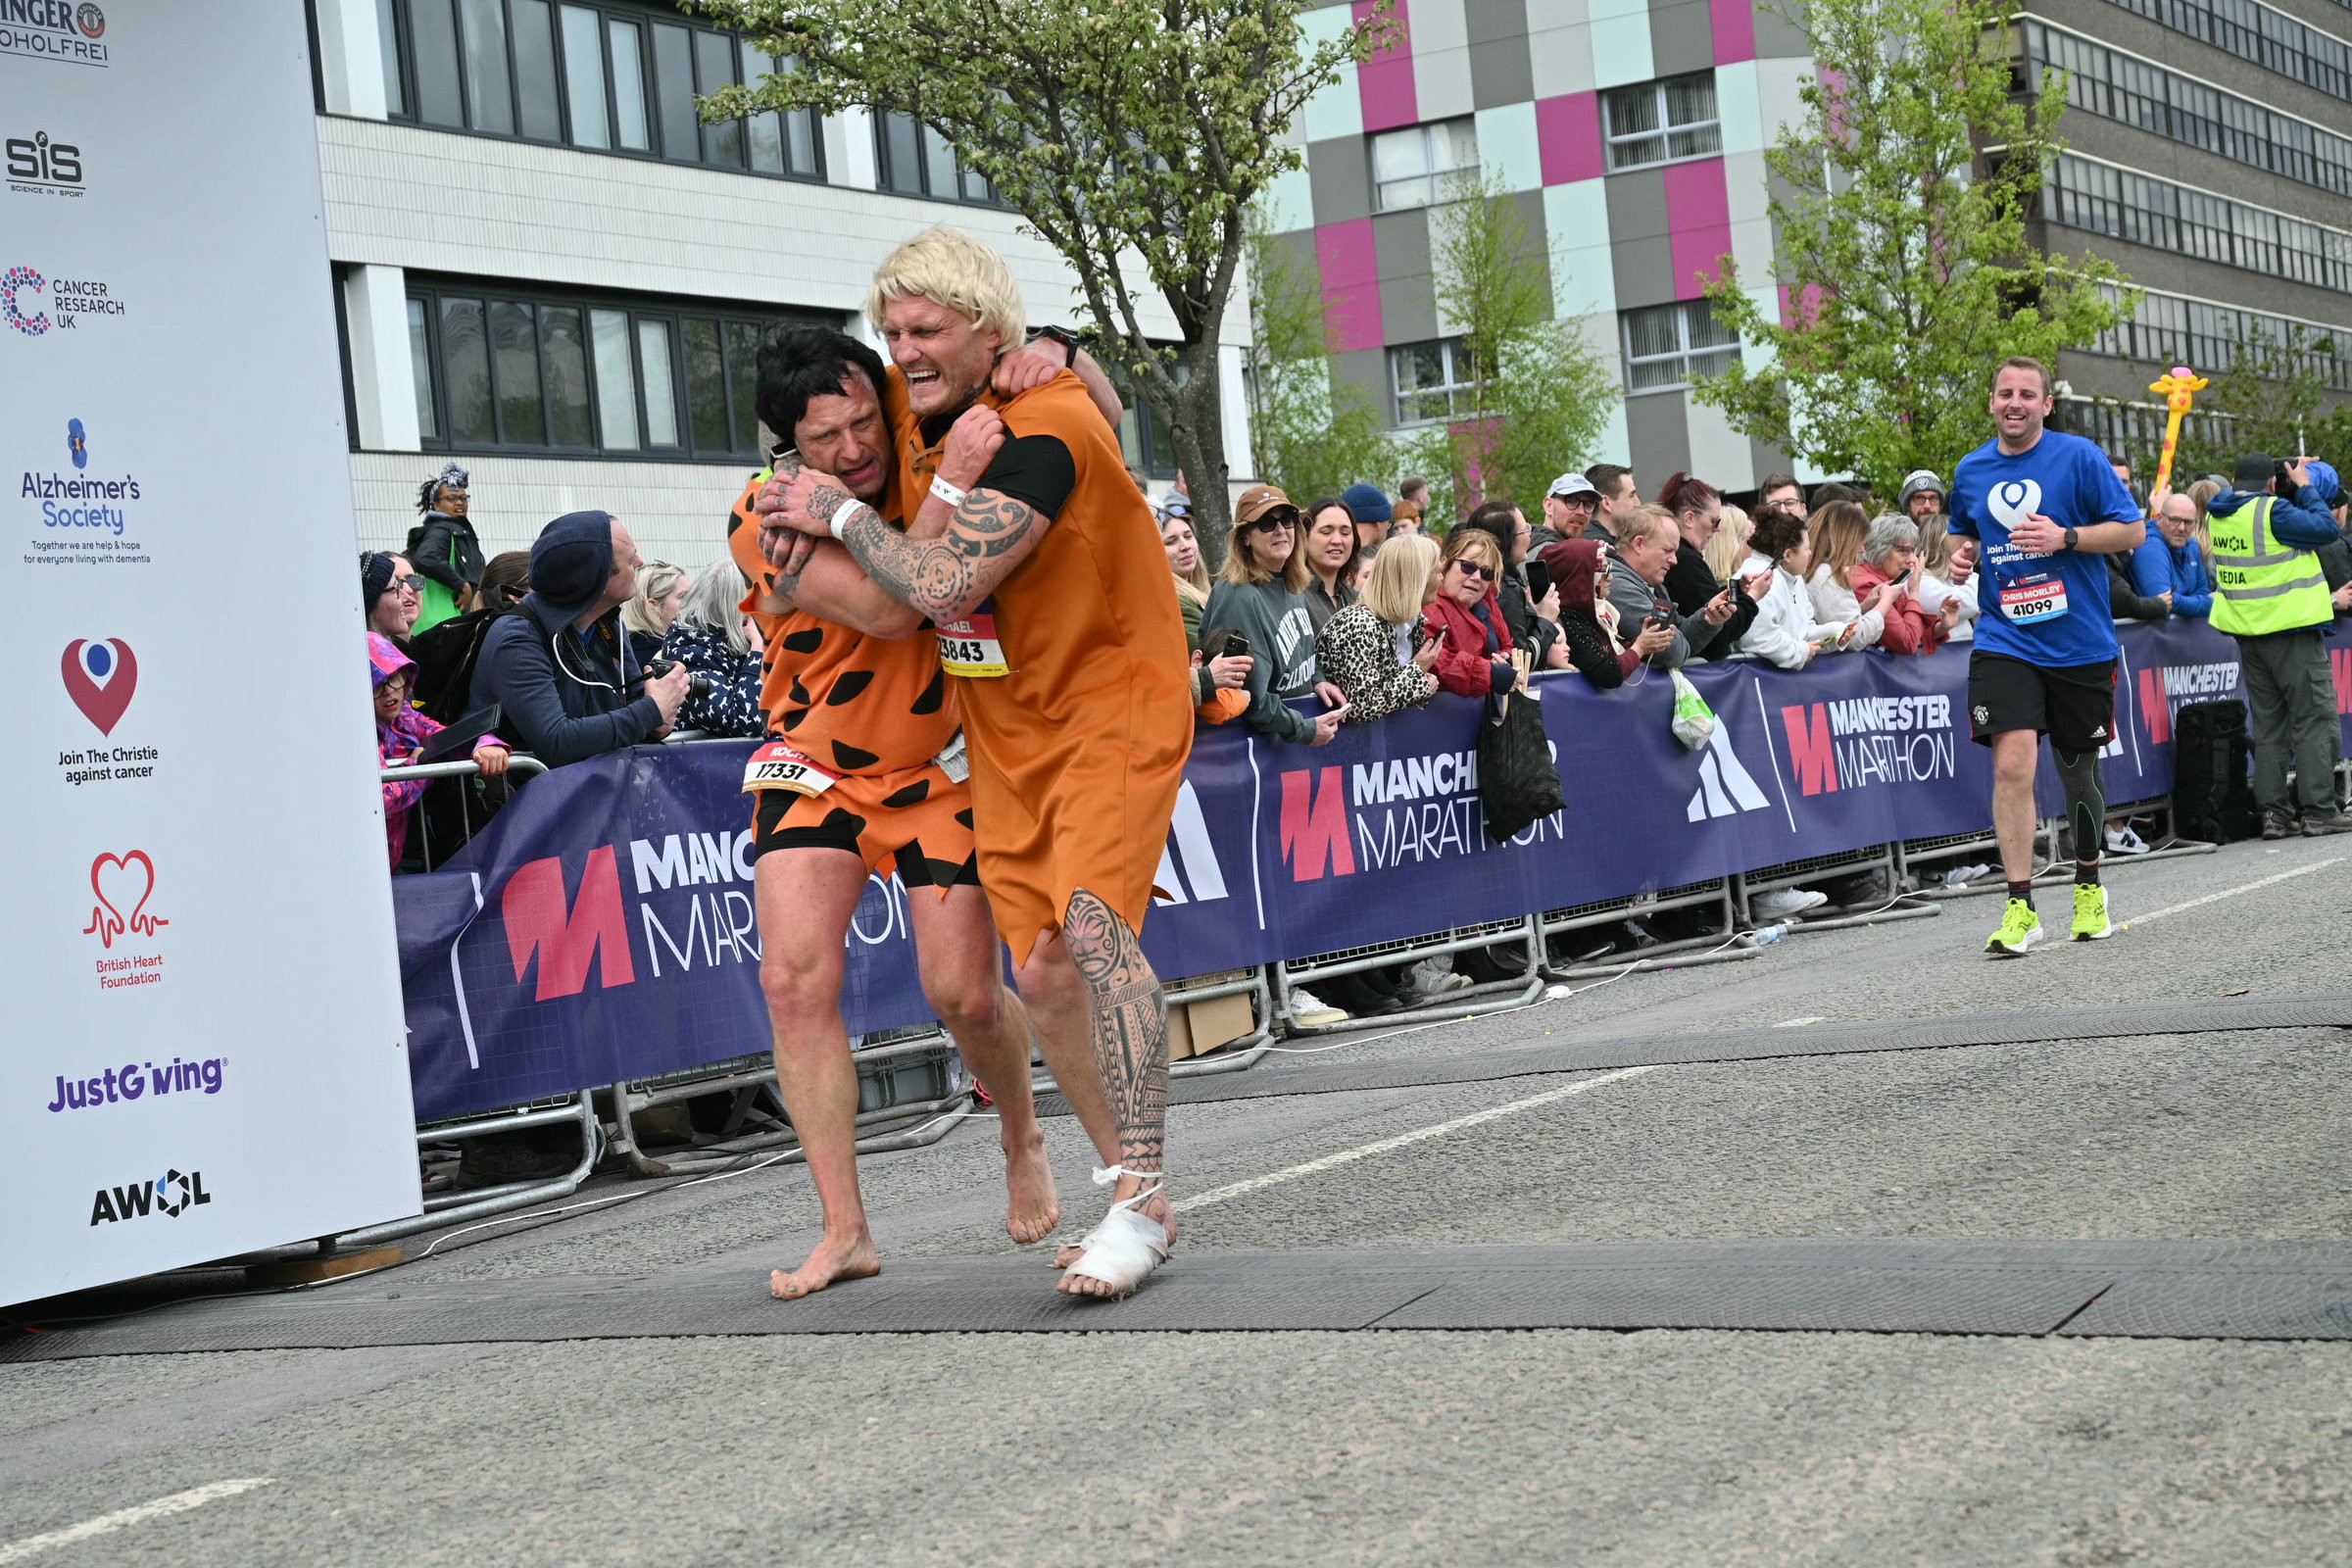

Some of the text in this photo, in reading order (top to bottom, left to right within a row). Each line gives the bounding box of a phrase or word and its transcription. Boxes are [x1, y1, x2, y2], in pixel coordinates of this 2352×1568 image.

[0, 29, 109, 61] OHOLFREI
[11, 184, 43, 195] SCIENCE
[59, 189, 84, 198] SPORT
[53, 279, 108, 297] CANCER
[55, 296, 125, 316] RESEARCH
[57, 314, 76, 329] UK
[22, 471, 141, 501] Alzheimer's
[42, 500, 124, 536] Society
[31, 540, 67, 552] Together
[95, 540, 113, 551] help
[114, 540, 120, 550] &
[121, 540, 141, 551] hope
[1986, 545, 2003, 555] Join
[24, 554, 151, 565] for everyone living with dementia
[1990, 552, 2024, 564] against
[2002, 584, 2061, 602] CHRIS MORLEY
[2013, 599, 2052, 616] 41099
[2163, 662, 2240, 696] MANCHESTER
[58, 746, 159, 765] Join The Christie
[66, 765, 154, 786] against cancer
[756, 762, 808, 780] 17331
[96, 954, 164, 973] British Heart
[100, 971, 162, 990] Foundation
